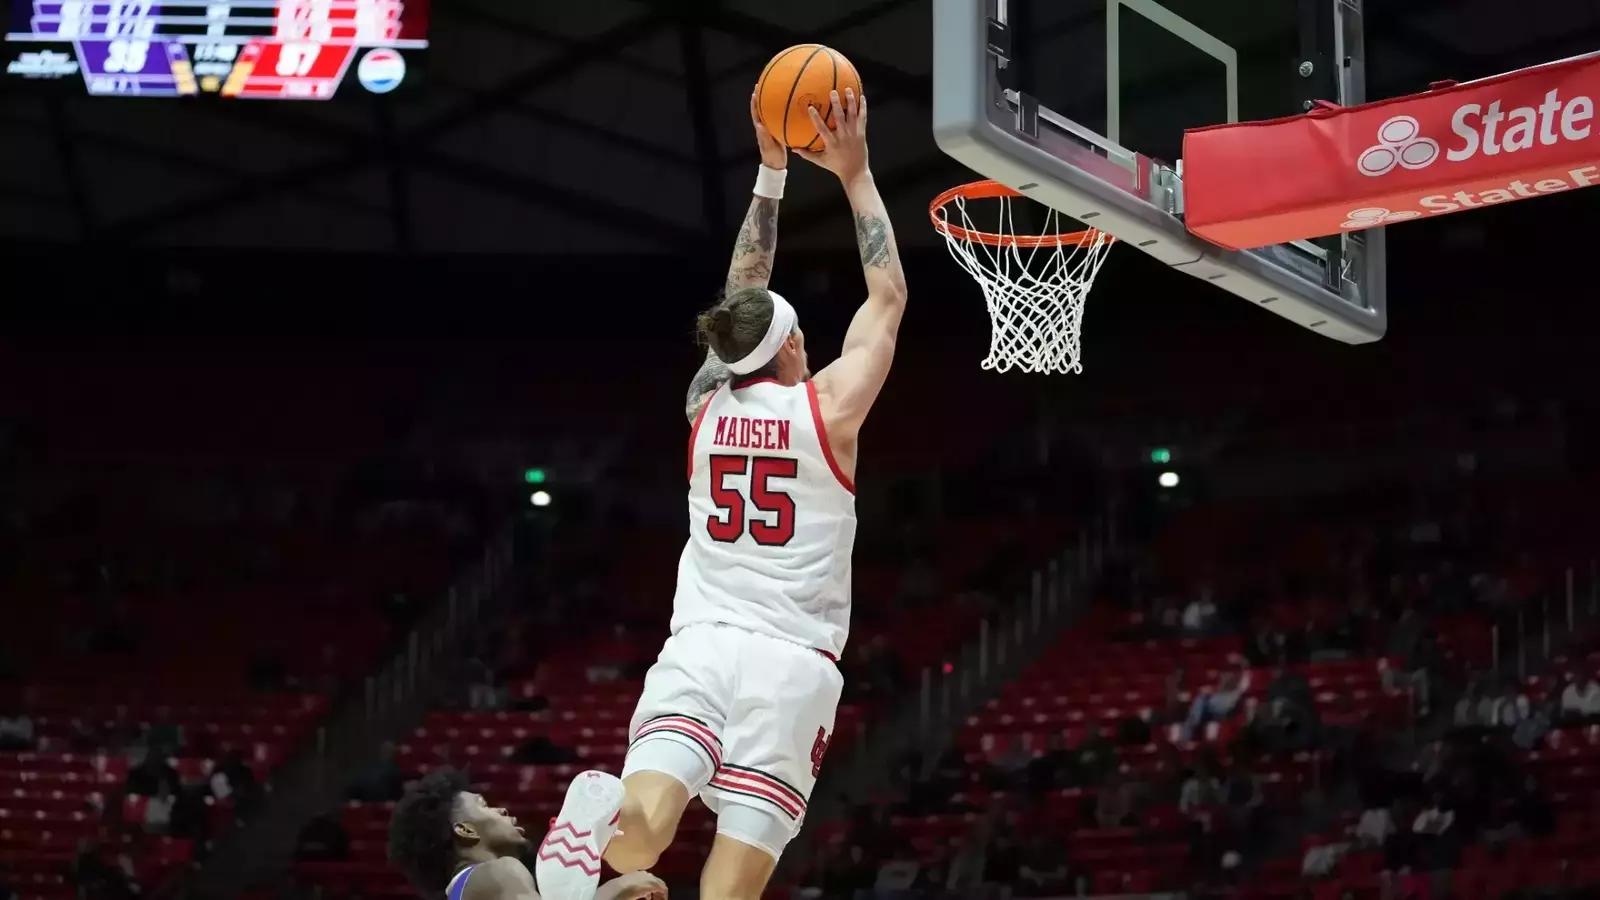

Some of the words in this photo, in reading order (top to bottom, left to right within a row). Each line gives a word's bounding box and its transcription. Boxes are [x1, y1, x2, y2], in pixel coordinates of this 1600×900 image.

[1446, 88, 1594, 162] State
[1419, 179, 1570, 214] State
[713, 416, 790, 450] MADSEN
[706, 454, 798, 547] 55
